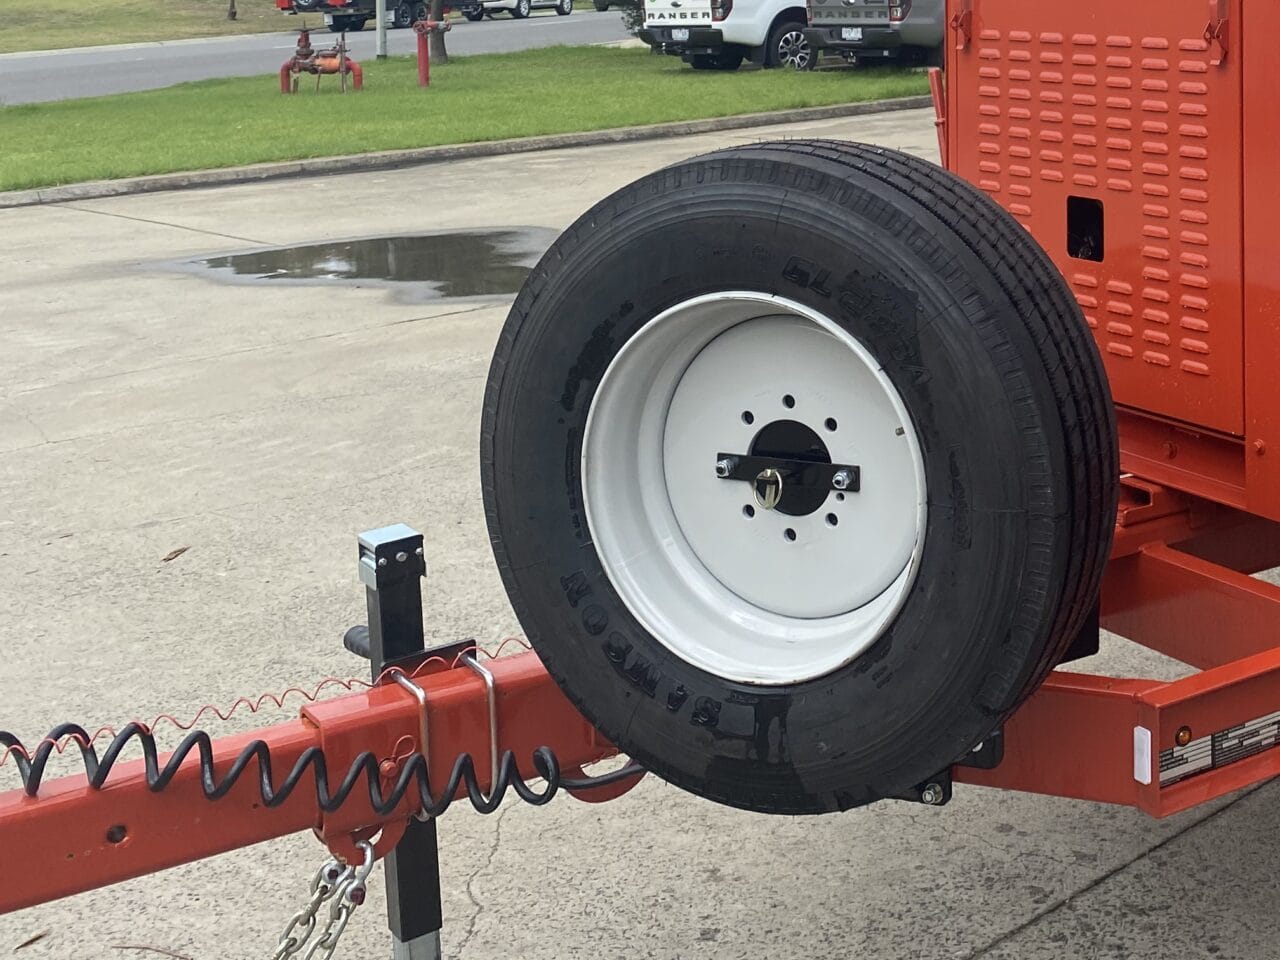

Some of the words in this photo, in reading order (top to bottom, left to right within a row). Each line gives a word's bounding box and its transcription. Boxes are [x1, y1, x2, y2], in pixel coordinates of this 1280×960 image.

[647, 11, 710, 20] RANGER
[813, 10, 889, 19] RANGER
[560, 568, 722, 728] SAMSON
